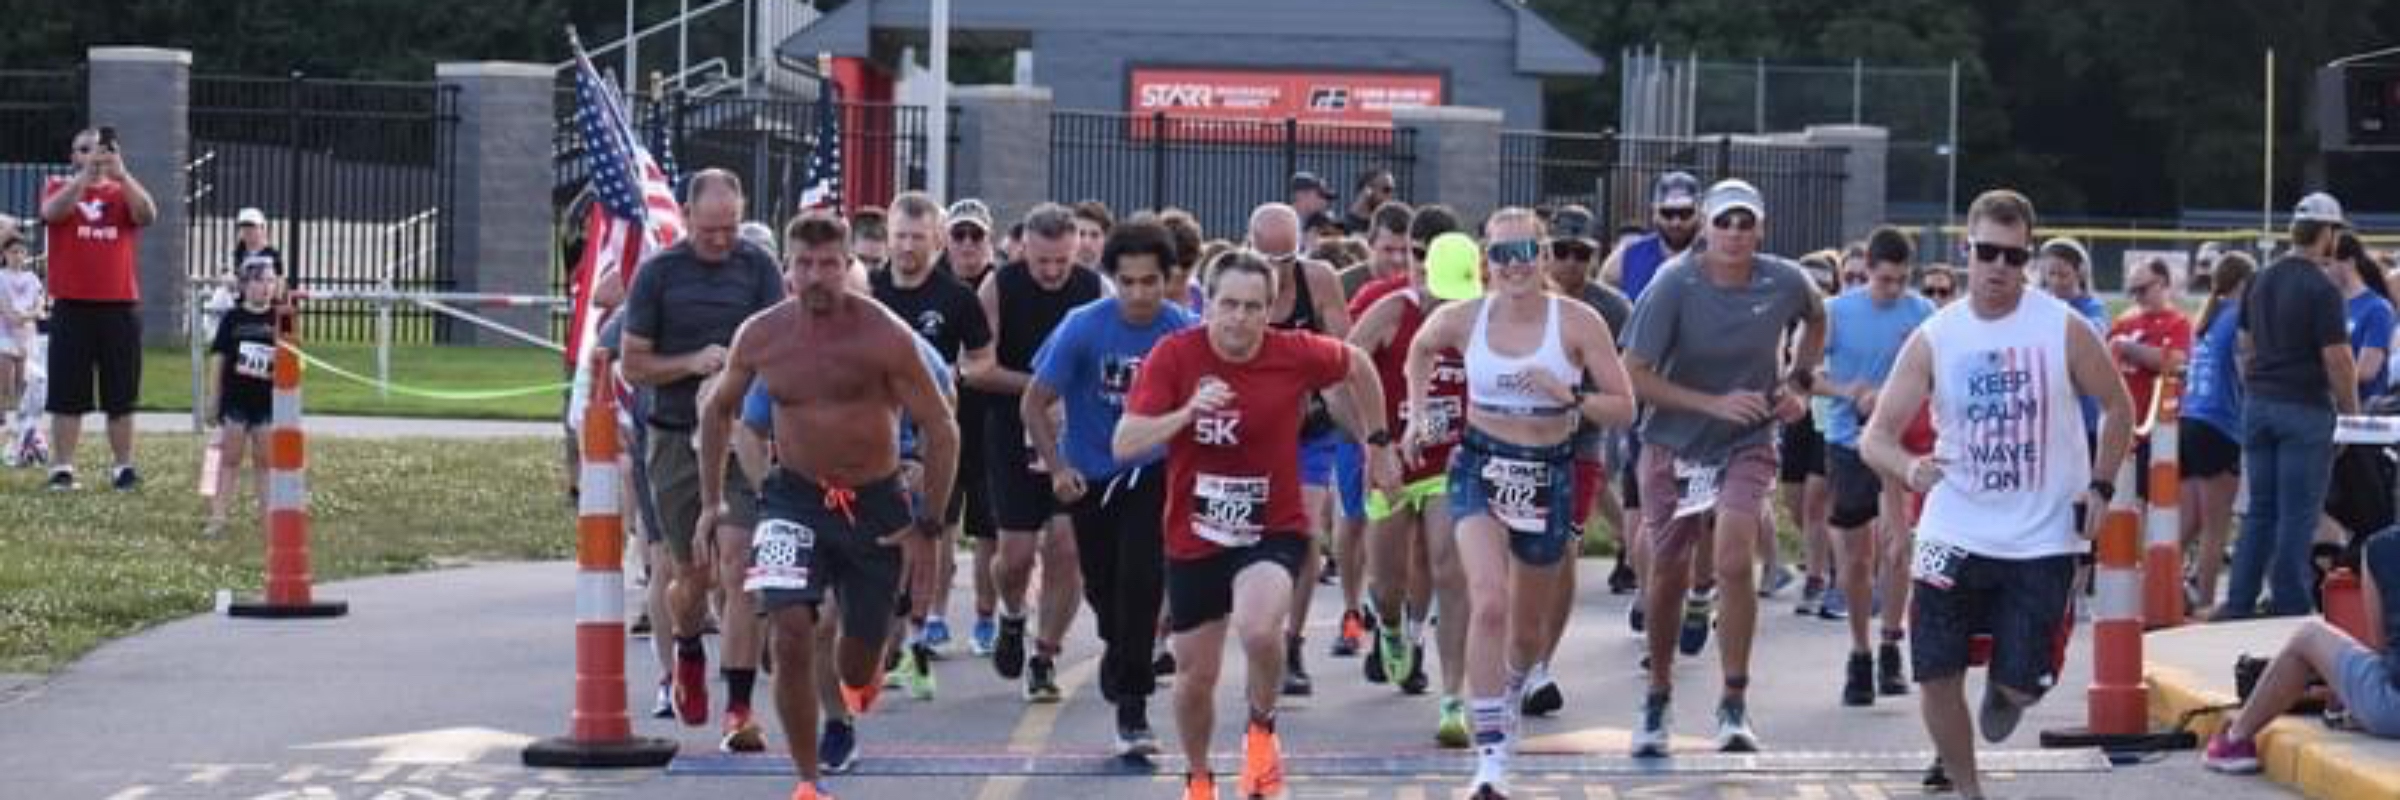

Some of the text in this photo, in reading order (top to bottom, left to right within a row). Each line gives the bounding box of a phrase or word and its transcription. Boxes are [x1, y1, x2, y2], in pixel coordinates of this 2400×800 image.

[1141, 83, 1213, 107] STARR
[1968, 371, 2032, 396] KEEP
[1196, 419, 1239, 445] 5K
[1967, 441, 2037, 464] WAVE
[1983, 470, 2020, 489] ON
[1494, 485, 1536, 506] 702
[1208, 500, 1251, 522] 502
